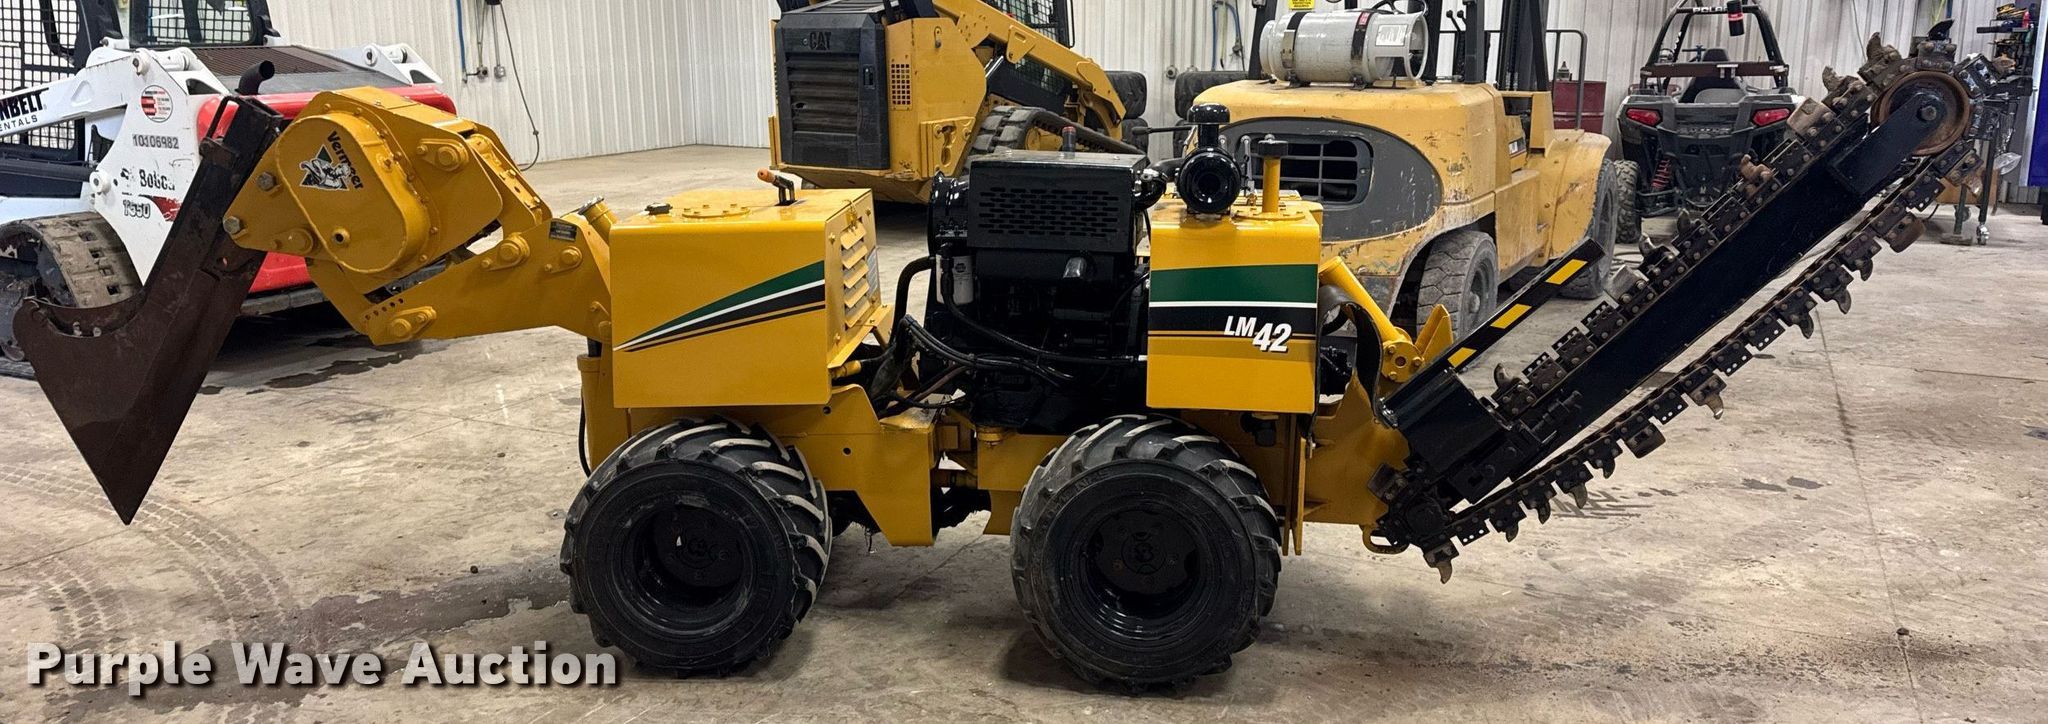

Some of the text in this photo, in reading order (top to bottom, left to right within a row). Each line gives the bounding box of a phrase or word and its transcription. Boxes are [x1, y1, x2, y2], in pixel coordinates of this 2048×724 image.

[810, 31, 832, 51] CAT
[132, 134, 179, 149] 10106982
[327, 130, 364, 189] Vermeer
[139, 168, 175, 191] Bobc
